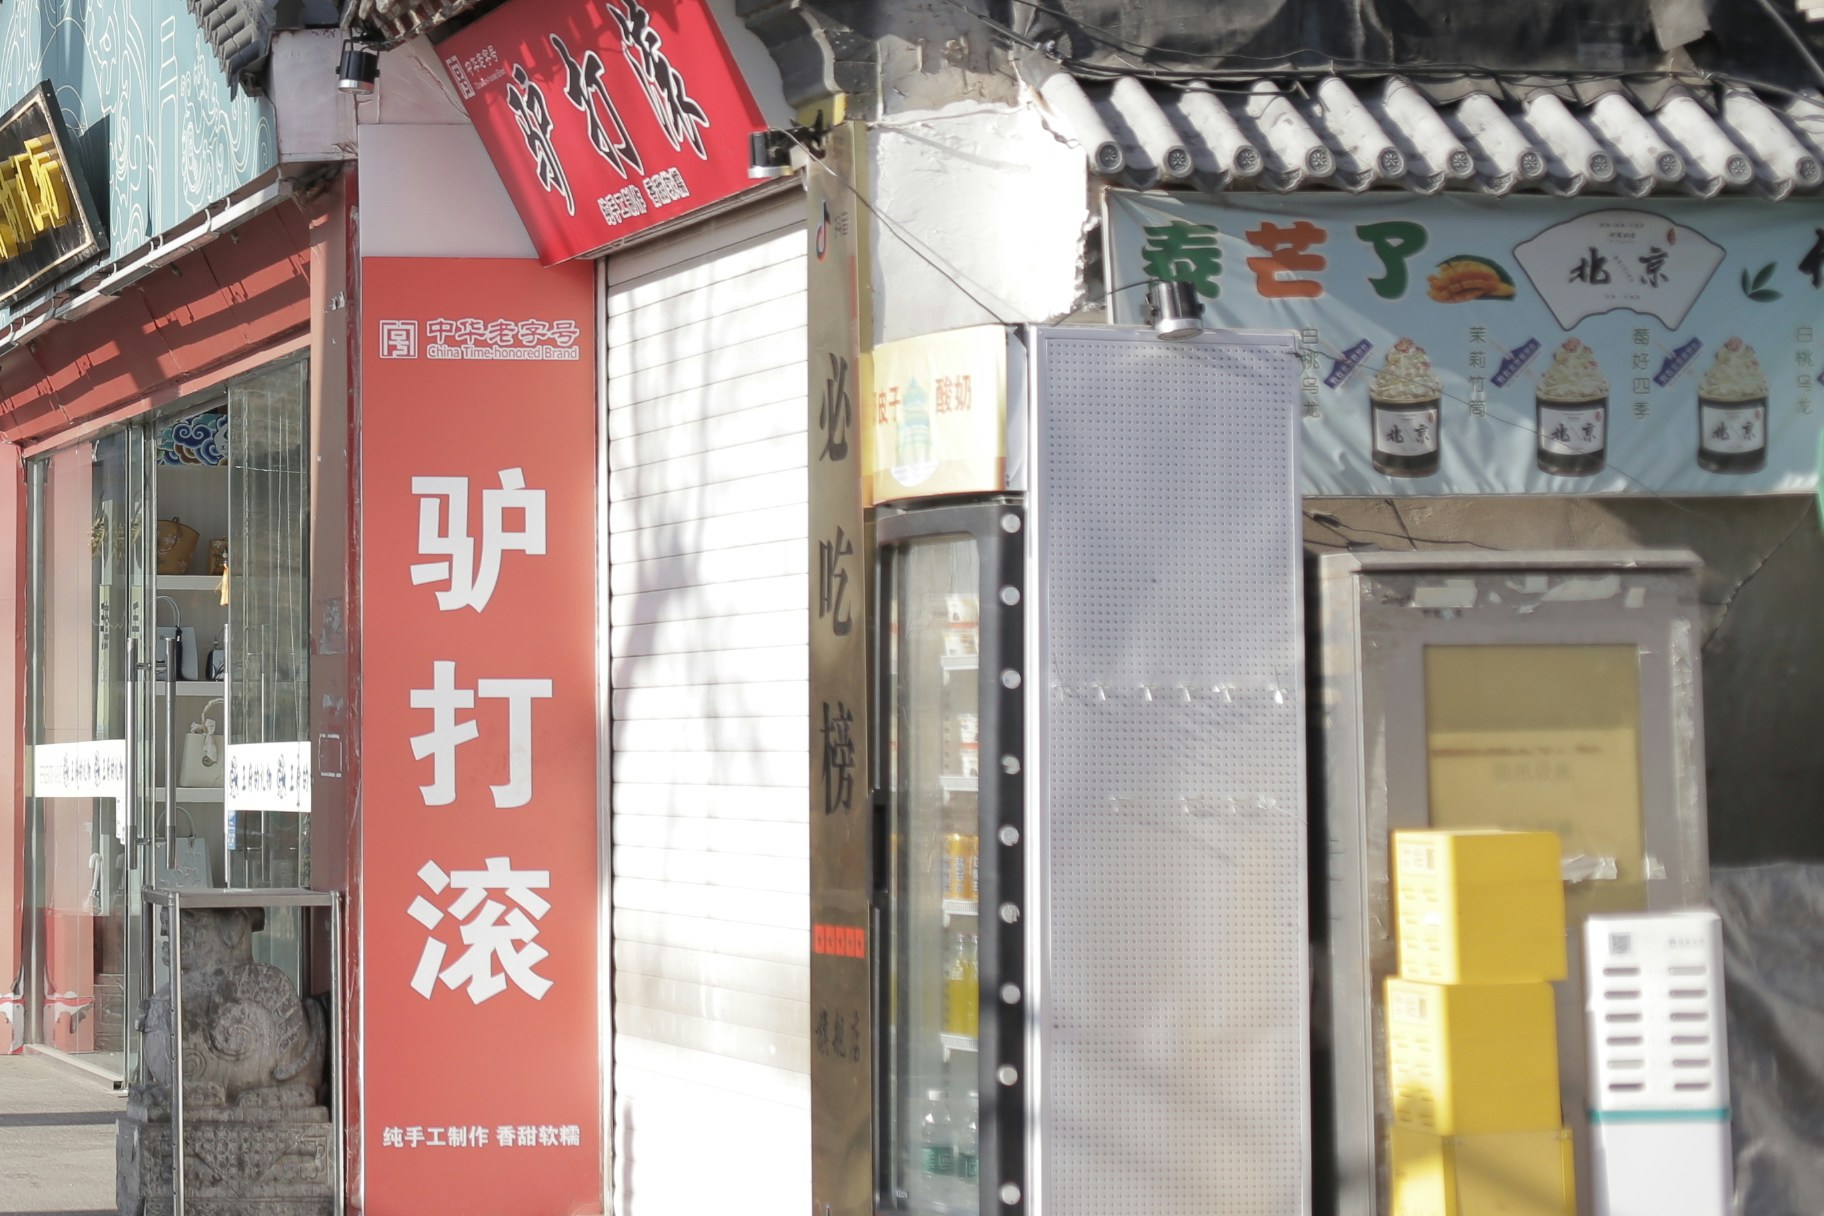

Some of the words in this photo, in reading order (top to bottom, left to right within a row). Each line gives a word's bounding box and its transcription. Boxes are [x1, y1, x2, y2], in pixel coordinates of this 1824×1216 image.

[1569, 246, 1669, 288] 北京
[426, 318, 580, 346] 中华老字号
[428, 345, 461, 359] China
[463, 345, 541, 359] Time-honored
[544, 345, 578, 359] Brand
[1795, 325, 1814, 415] 白桃乌龙
[872, 386, 901, 424] 皮子
[935, 374, 972, 414] 酸奶
[819, 352, 856, 815] 必吃榜
[407, 466, 555, 1006] 驴打滚
[383, 1126, 490, 1147] 纯手工制作
[496, 1125, 580, 1147] 香甜软糯
